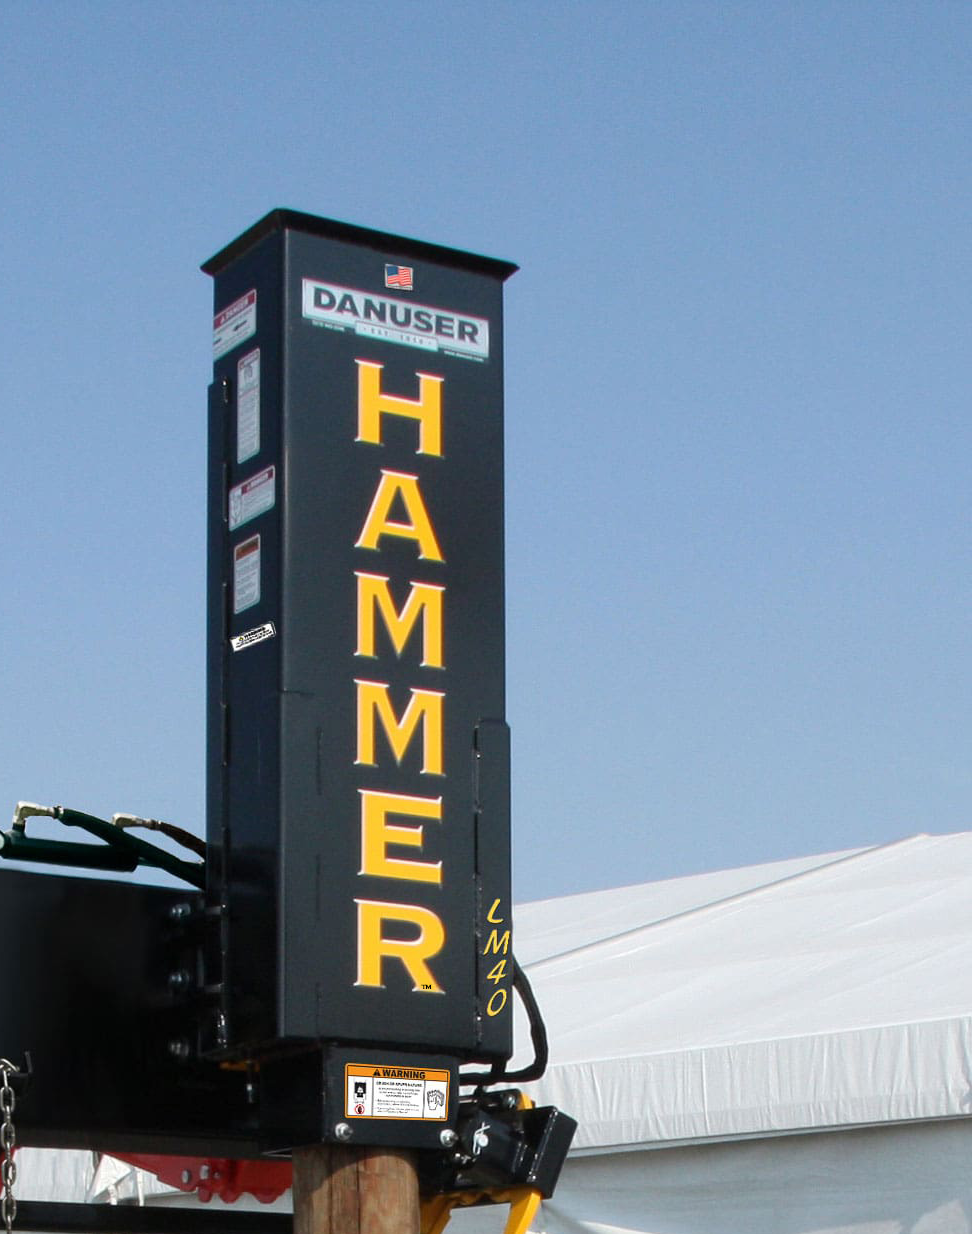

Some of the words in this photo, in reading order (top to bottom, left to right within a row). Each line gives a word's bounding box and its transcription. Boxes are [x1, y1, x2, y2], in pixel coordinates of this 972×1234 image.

[313, 286, 480, 345] DANUSER
[353, 358, 447, 995] HAMMER
[483, 898, 510, 1017] LM40
[382, 1069, 426, 1080] WARNING
